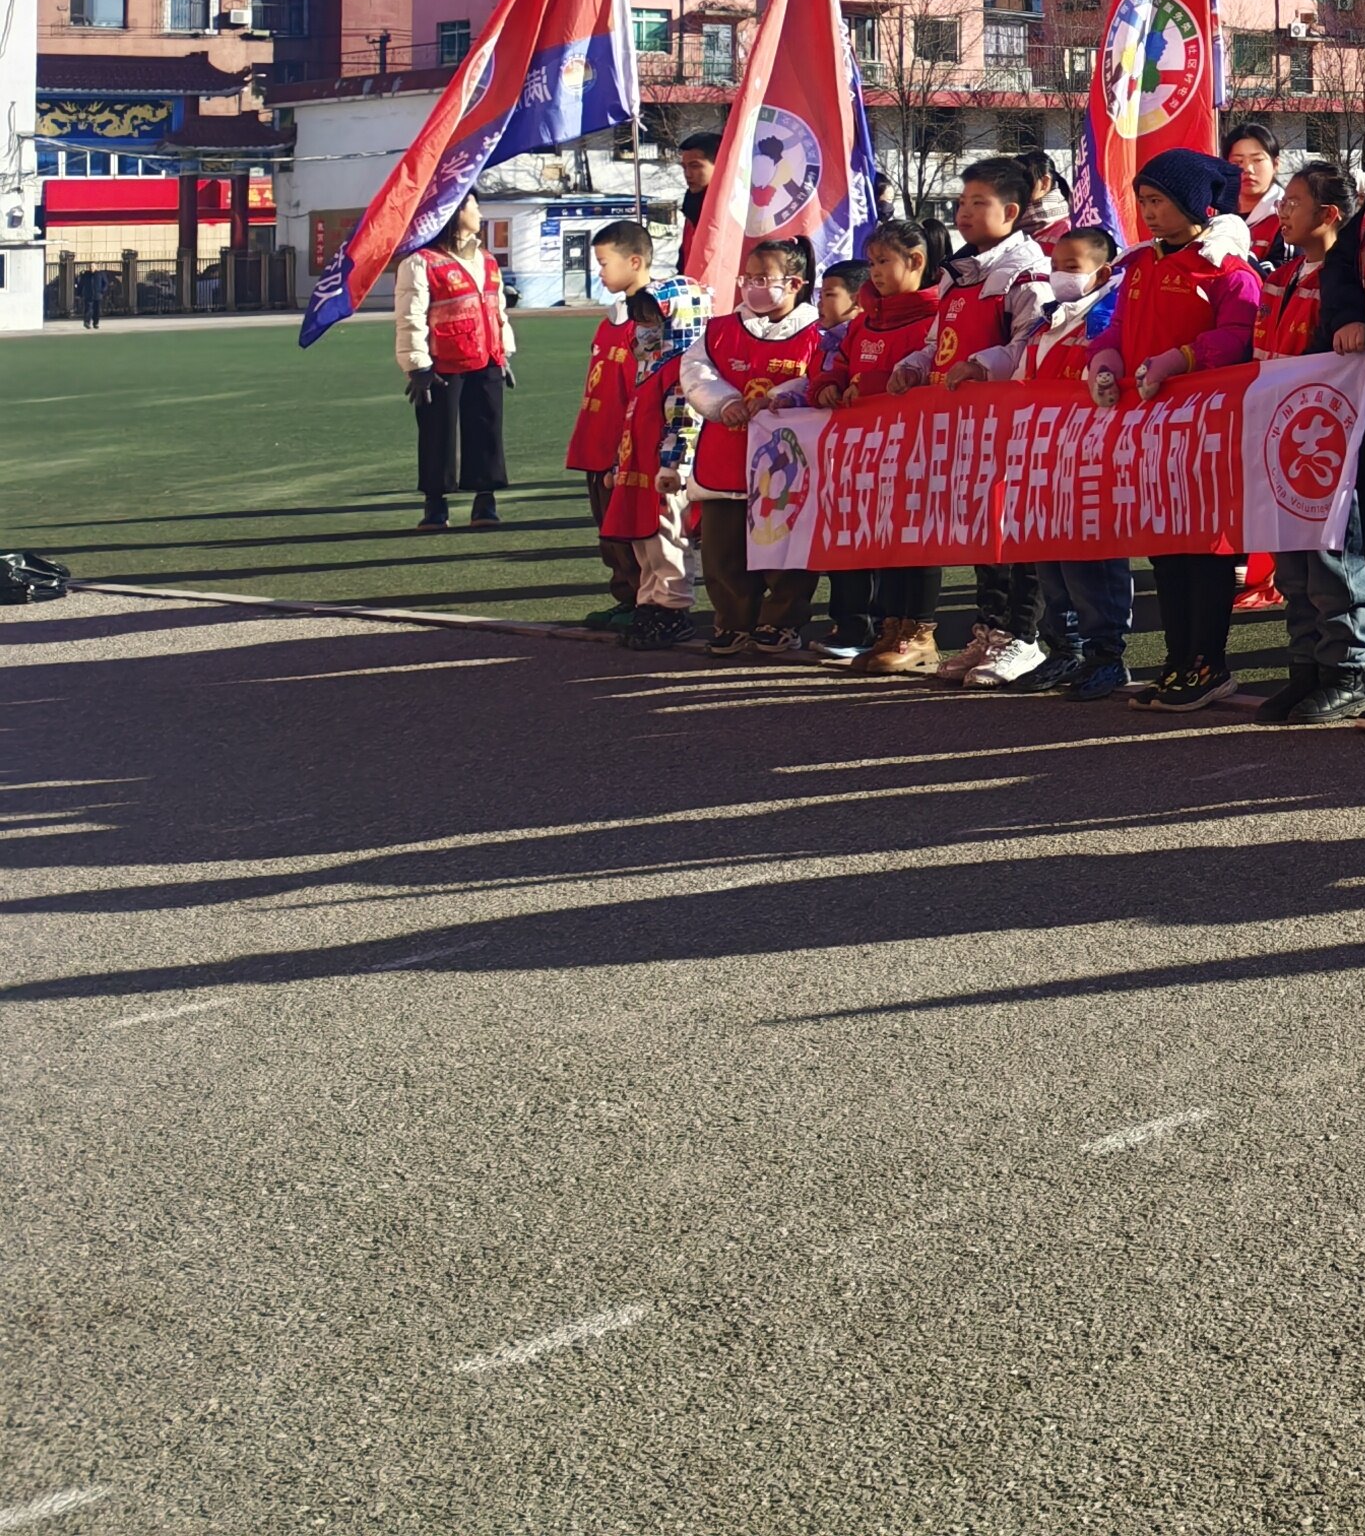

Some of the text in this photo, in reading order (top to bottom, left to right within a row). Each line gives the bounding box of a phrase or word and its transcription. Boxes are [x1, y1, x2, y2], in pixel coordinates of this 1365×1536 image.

[820, 411, 905, 551] 冬至安康
[900, 403, 999, 547] 全民健身
[1001, 402, 1116, 544] 爱民拥警
